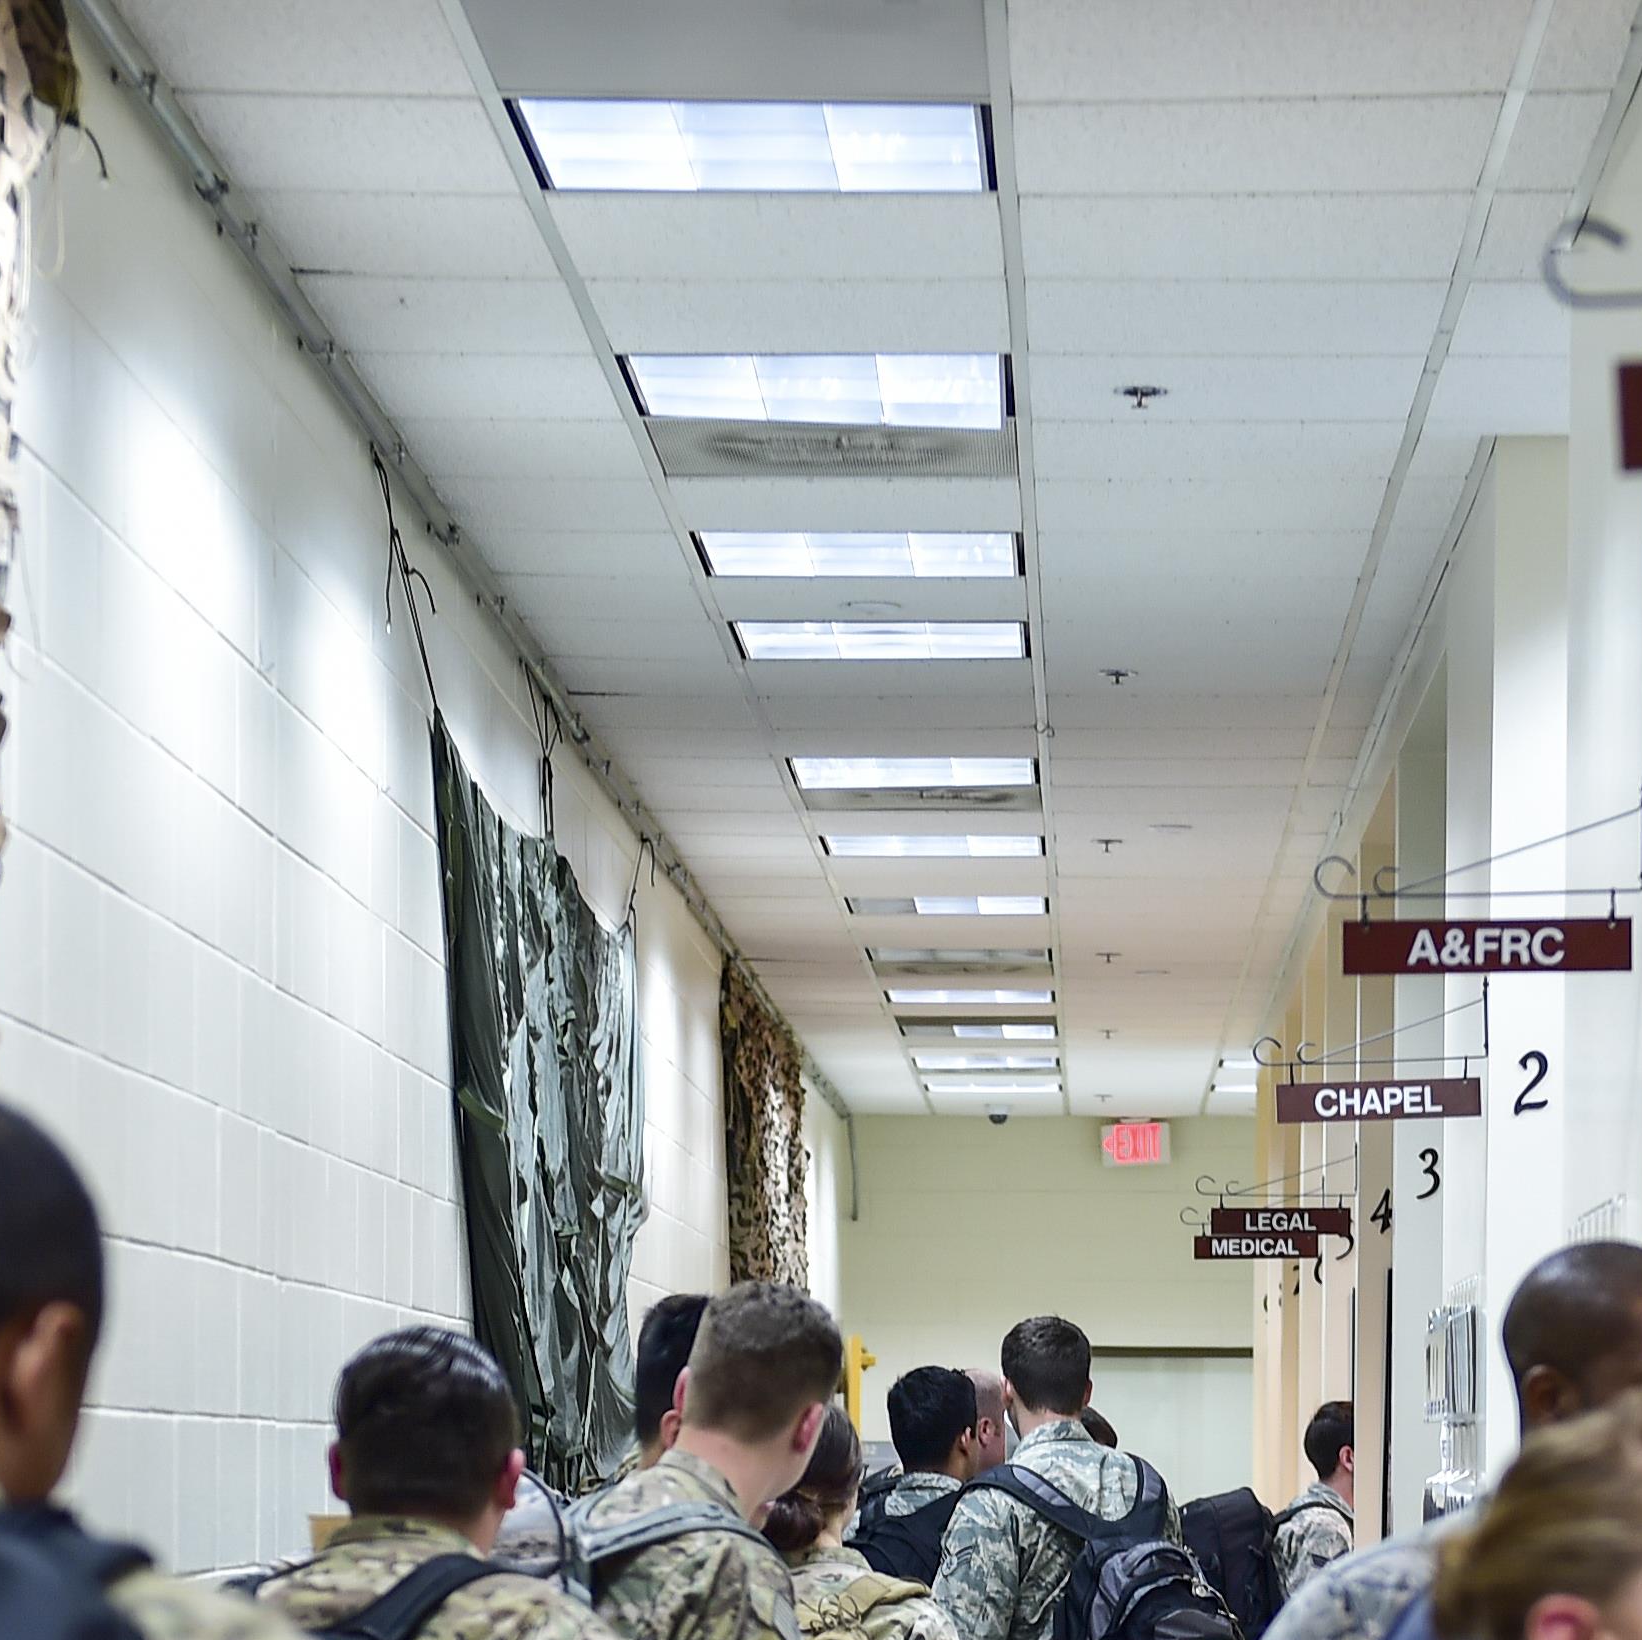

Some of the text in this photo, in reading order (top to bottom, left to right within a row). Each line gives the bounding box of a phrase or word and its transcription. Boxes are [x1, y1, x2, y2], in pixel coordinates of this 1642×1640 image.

[1407, 926, 1565, 968] A&FRC
[1314, 1086, 1443, 1117] CHAPEL
[1513, 1050, 1549, 1115] 2
[1114, 1124, 1161, 1161] EXIT
[1416, 1148, 1440, 1199] 3
[1245, 1212, 1317, 1232] LEGAL
[1370, 1188, 1393, 1234] 4
[1211, 1238, 1300, 1256] MEDICAL
